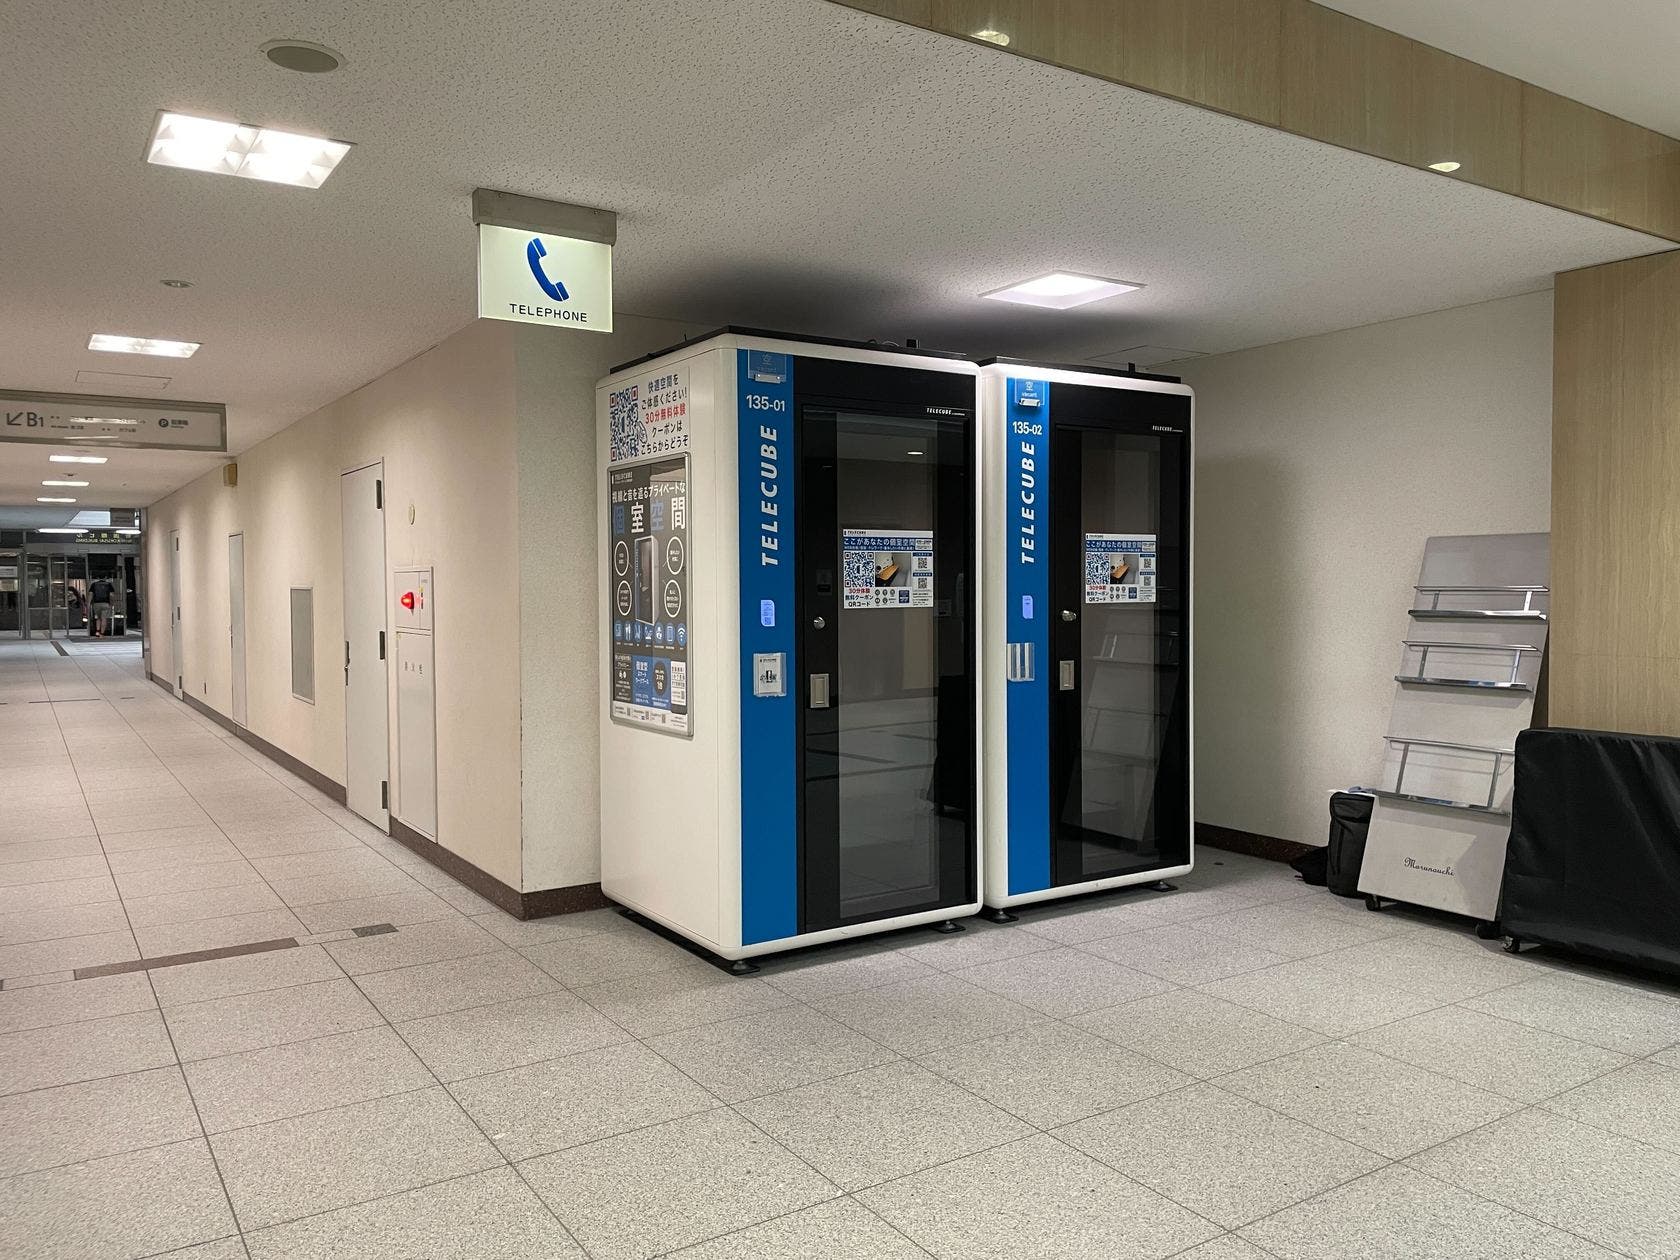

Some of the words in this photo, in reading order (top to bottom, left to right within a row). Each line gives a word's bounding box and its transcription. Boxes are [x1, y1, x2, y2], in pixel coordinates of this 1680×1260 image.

[509, 303, 587, 322] TELEPHONE
[648, 374, 679, 394] 快適空間を
[746, 394, 785, 412] 135-01
[926, 407, 952, 415] TELECUBE
[26, 411, 44, 428] B1
[645, 402, 687, 425] 30分無料体験
[652, 420, 683, 439] クーポンは
[1012, 421, 1043, 436] 135-02
[641, 434, 689, 456] こちらからどうぞ
[760, 425, 779, 566] TELECUBE
[1021, 441, 1035, 564] TELECUBE
[843, 538, 916, 546] ここがあなたの個室空間
[1404, 857, 1455, 876] Marunouchi
